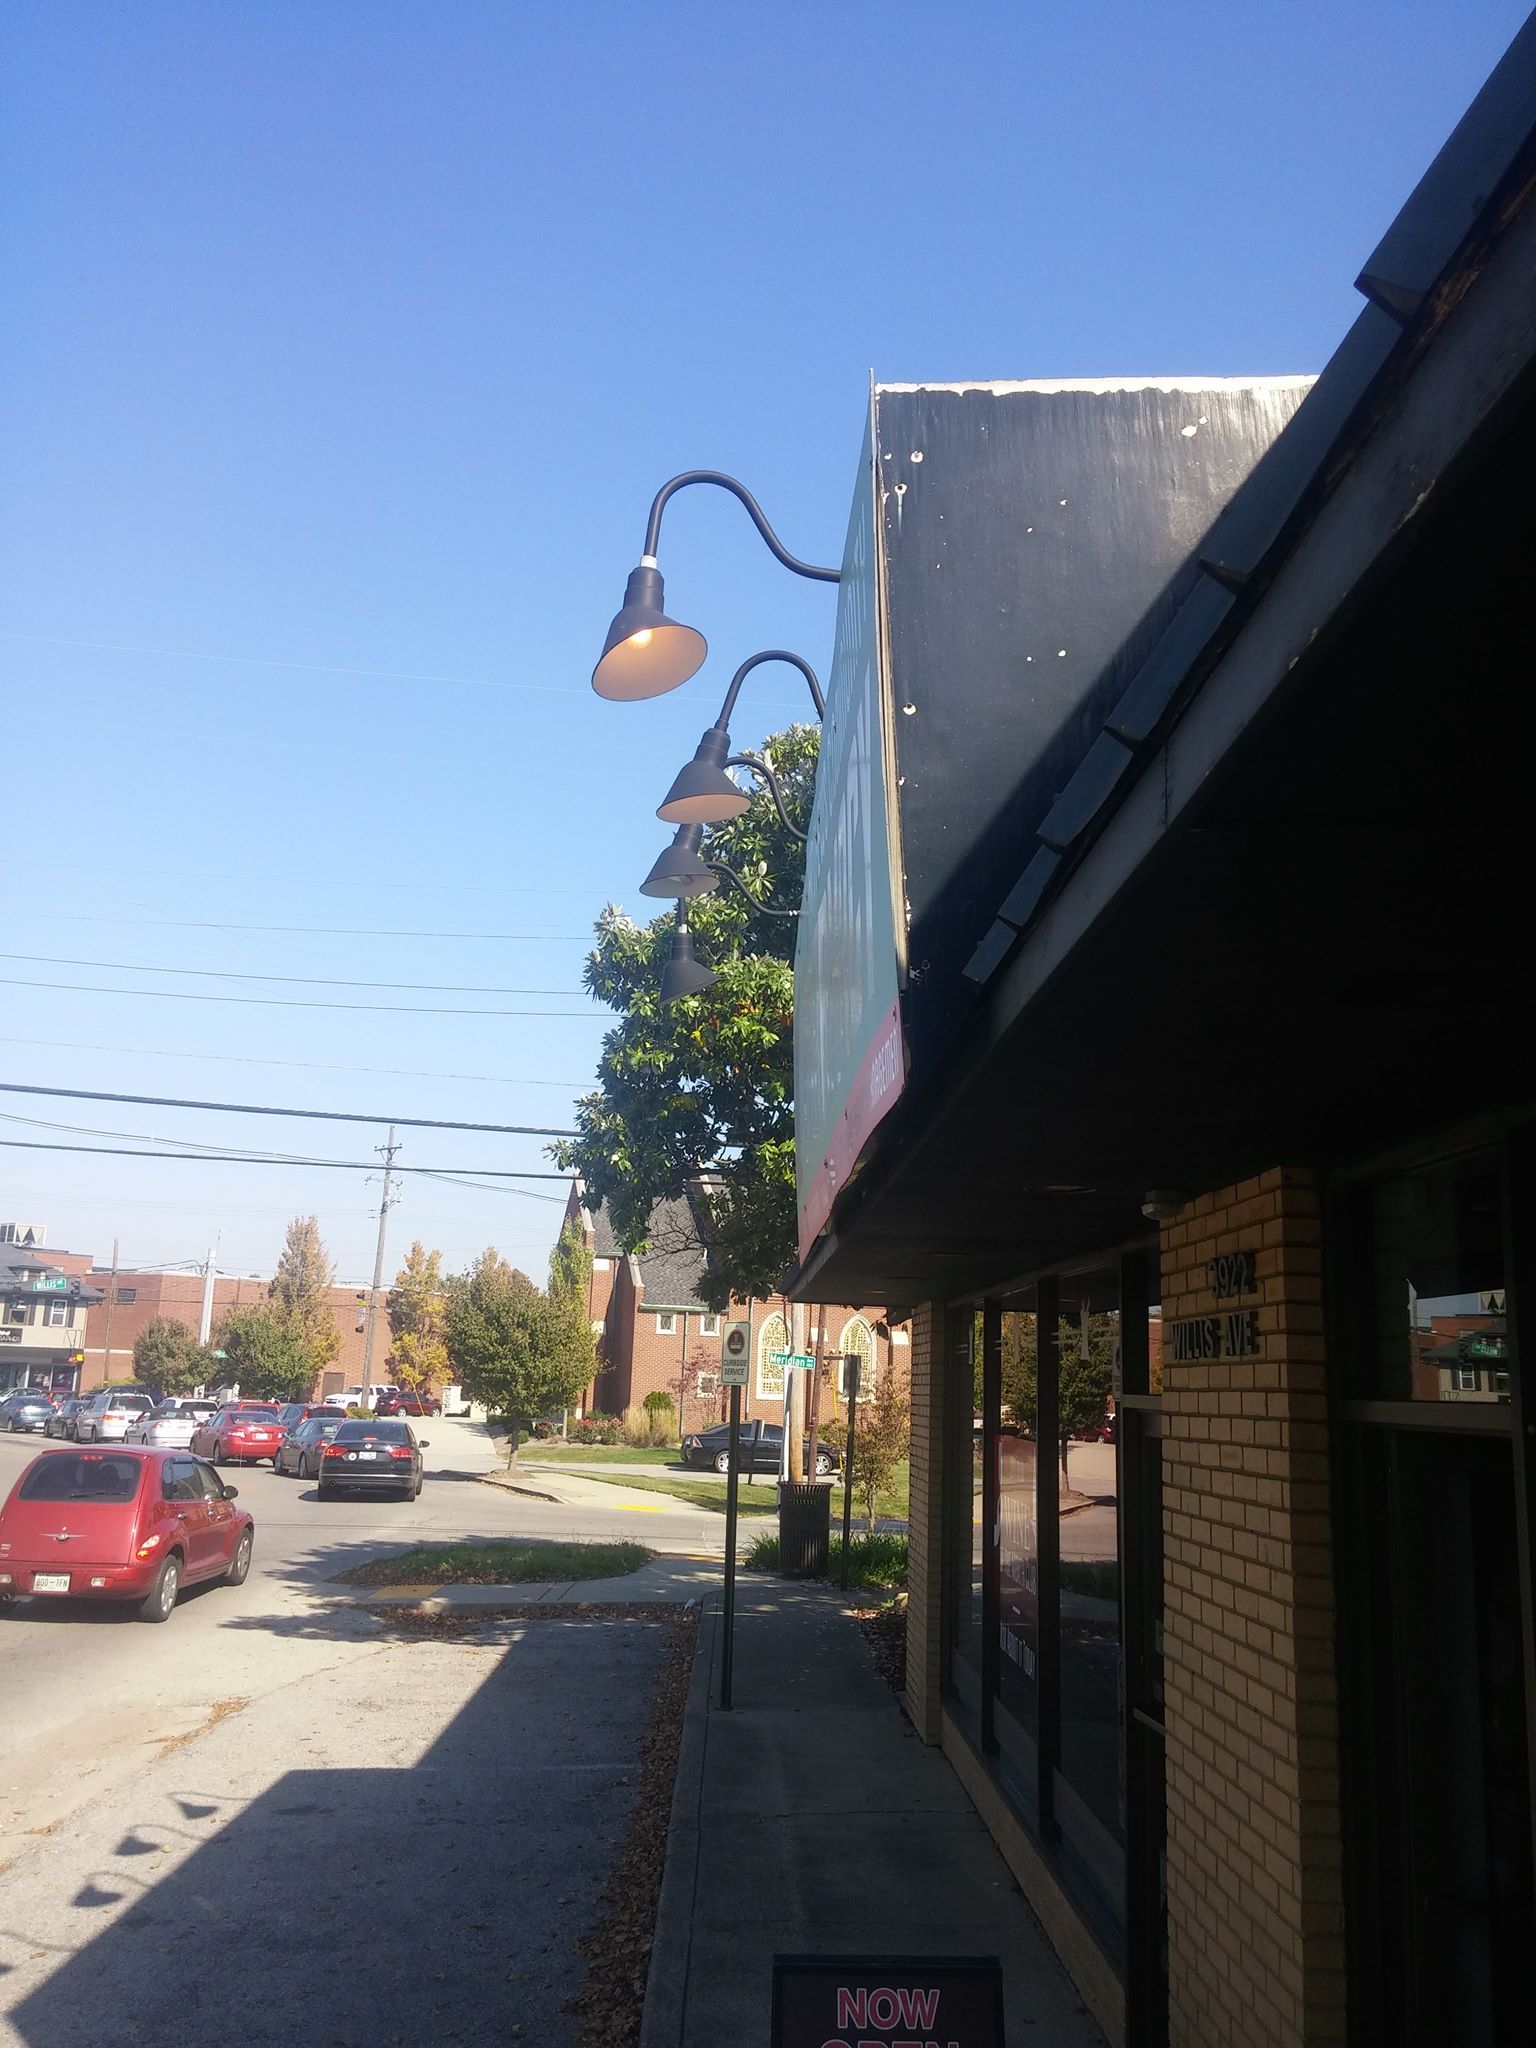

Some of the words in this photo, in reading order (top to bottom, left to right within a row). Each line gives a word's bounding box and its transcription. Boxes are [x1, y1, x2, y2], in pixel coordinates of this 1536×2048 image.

[1207, 1252, 1253, 1299] 3922
[36, 1280, 57, 1290] WILLIS
[1171, 1316, 1218, 1360] WILLIS
[1225, 1310, 1257, 1357] AVE
[723, 1359, 747, 1367] CURBSIDE
[769, 1353, 805, 1367] Meridian
[724, 1368, 744, 1376] SERVICE
[837, 1987, 940, 2030] NOW
